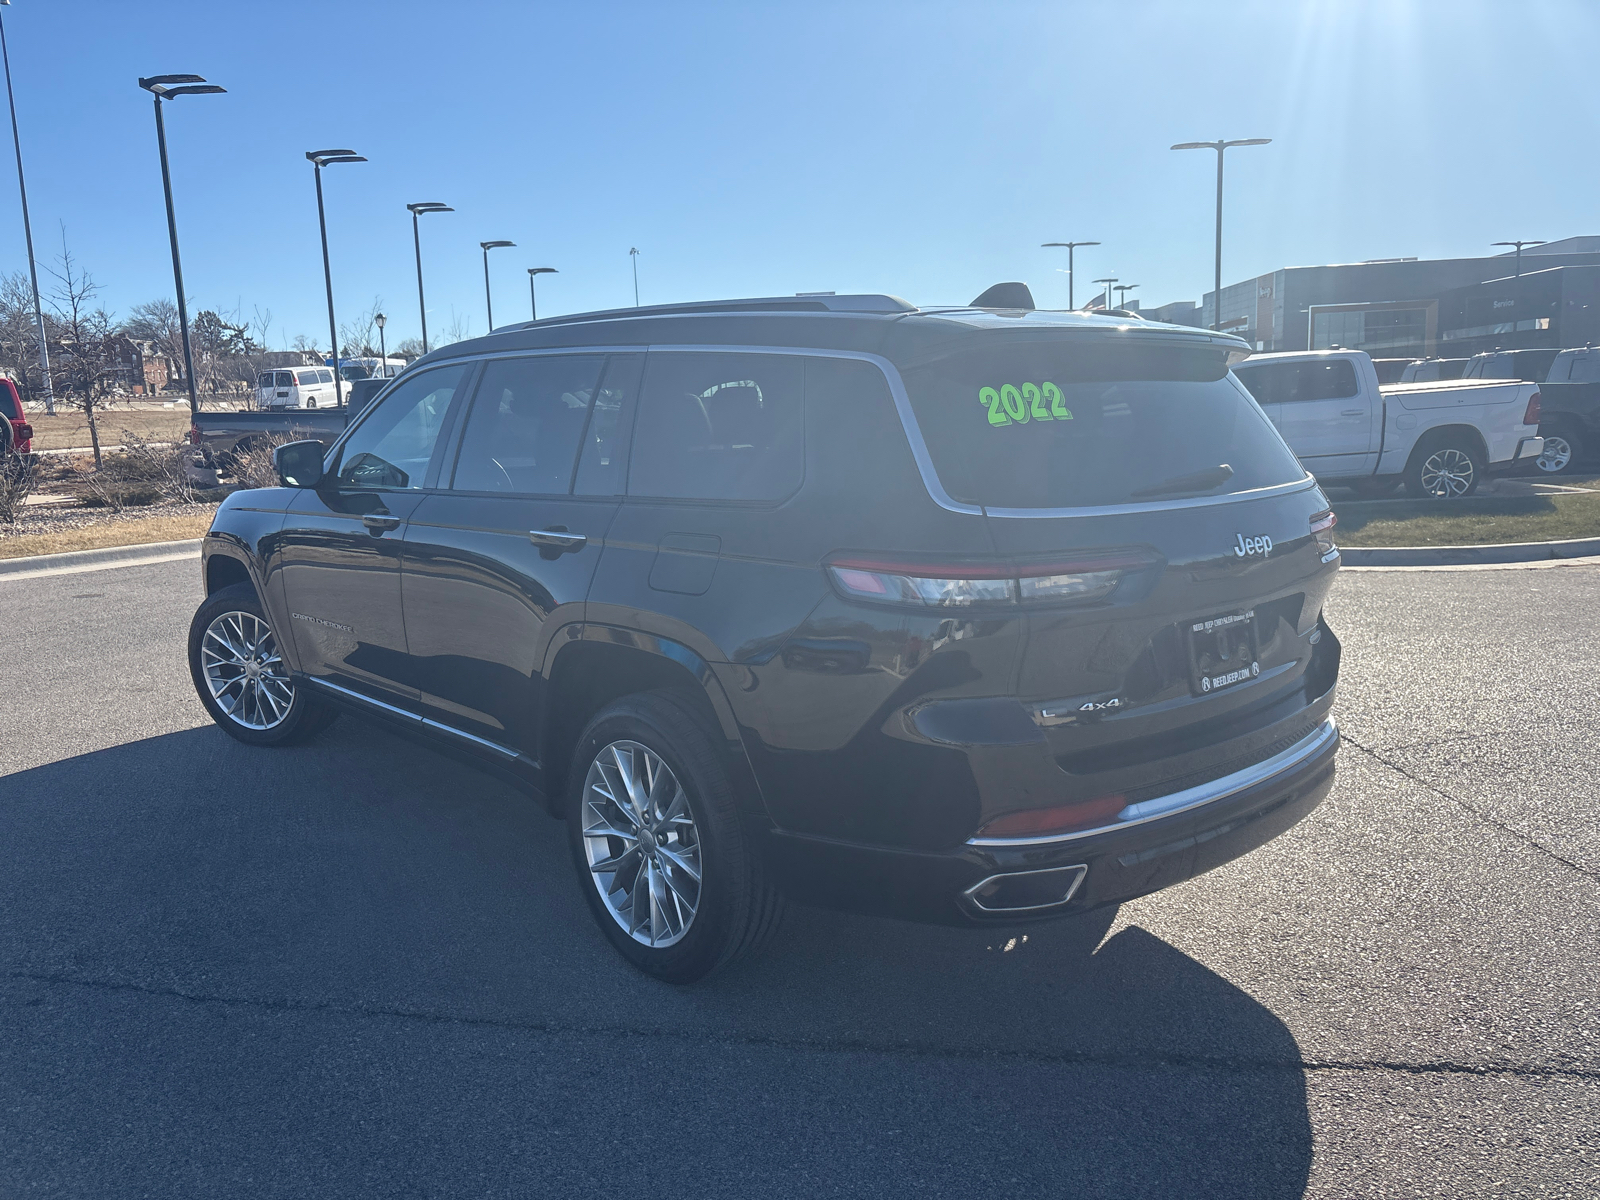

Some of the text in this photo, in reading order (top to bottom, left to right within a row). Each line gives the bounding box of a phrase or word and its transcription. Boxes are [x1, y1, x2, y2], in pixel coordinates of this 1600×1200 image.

[1493, 299, 1514, 308] Service
[979, 381, 1073, 428] 2022
[1234, 533, 1273, 558] Jeep
[292, 612, 353, 632] GRAND CHEROKEE
[1212, 668, 1249, 688] REEDJEEP.COM
[1042, 698, 1120, 717] L 4x4
